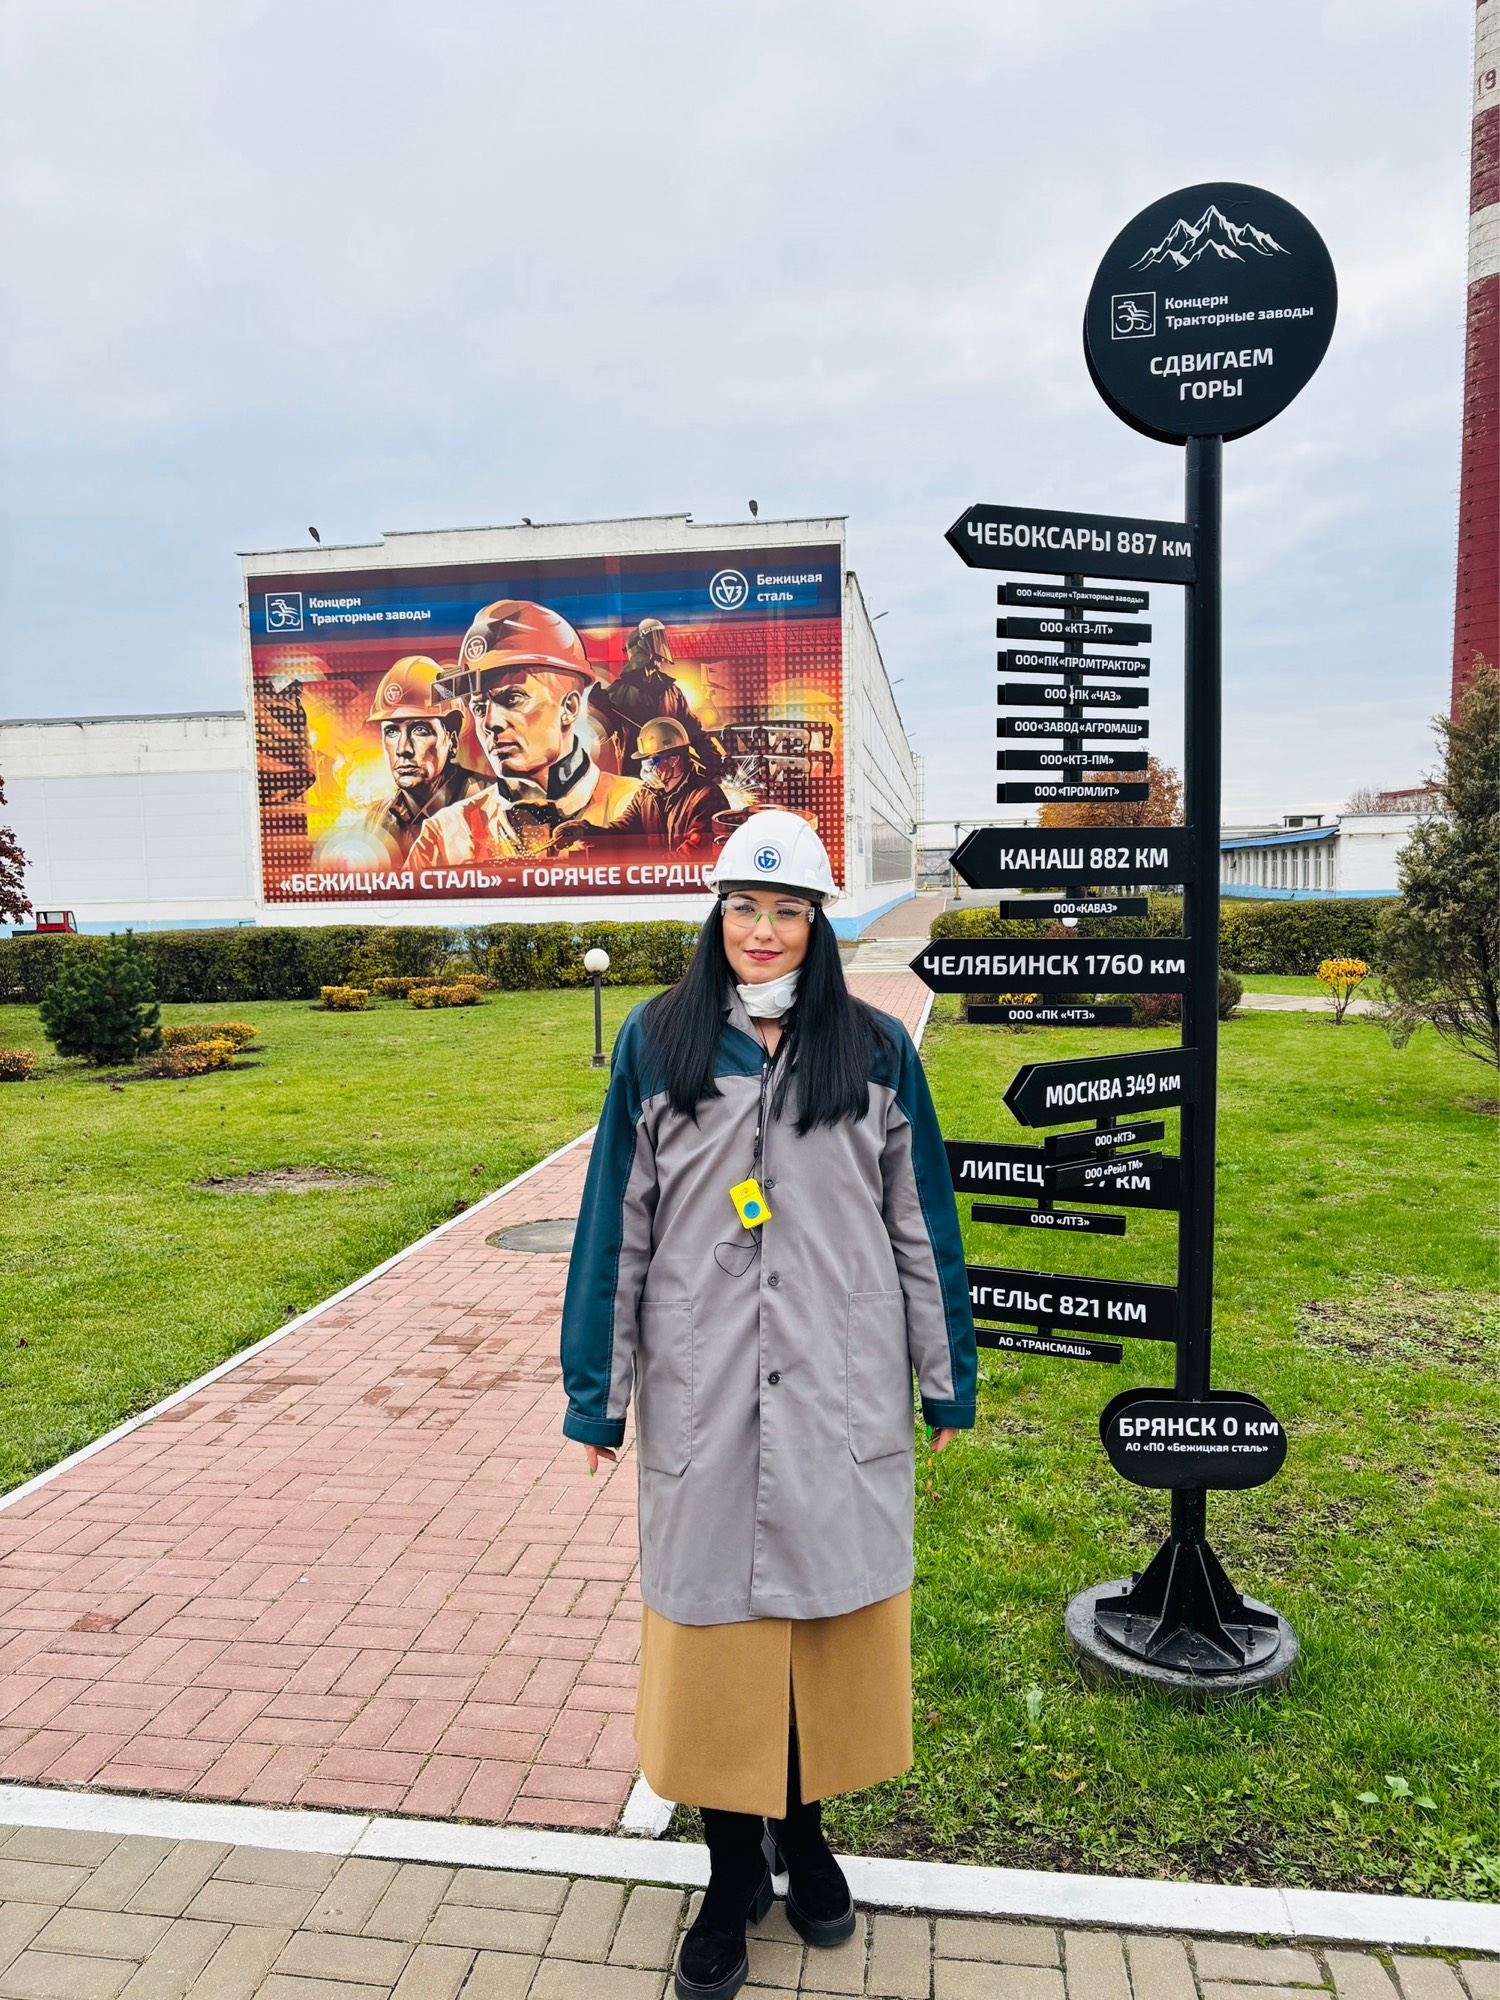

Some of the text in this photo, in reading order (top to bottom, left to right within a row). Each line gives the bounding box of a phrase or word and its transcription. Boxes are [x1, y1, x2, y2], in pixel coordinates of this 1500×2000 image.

[1165, 296, 1228, 309] Концерн
[1165, 307, 1313, 329] Тракторные заводы
[1151, 348, 1273, 377] СДВИГАЕМ
[1180, 379, 1242, 400] ГОРЫ
[968, 522, 1191, 557] ЧЕБОКСАРЫ 887 км
[757, 574, 822, 585] Бежицкая
[309, 598, 361, 609] Концерн
[757, 592, 793, 601] сталь
[1016, 588, 1033, 597] ООО
[1033, 589, 1068, 600] «Концерн
[1068, 590, 1115, 602] «Тракторные
[310, 611, 431, 626] Тракторные заводы
[1040, 622, 1113, 634] ООО «КТЗ-ЛТ»
[1045, 689, 1066, 699] ООО
[1091, 691, 1121, 701] «ЧАЗ»
[1001, 848, 1168, 869] КАНАШ 882 КМ
[279, 869, 415, 894] «БЕЖИЦКАЯ
[420, 868, 502, 891] СТАЛЬ»
[521, 865, 621, 888] ГОРЯЧЕЕ
[924, 955, 1185, 975] ЧЕЛЯБИНСК 1760 км
[1009, 1010, 1095, 1019] ООО «ПК «ЧТЗ»
[1046, 1073, 1180, 1107] МОСКВА 349 км
[1095, 1131, 1136, 1146] ООО «КТЗ»
[960, 1160, 1051, 1186] ЛИПЕЦ
[1085, 1160, 1143, 1179] ООО «Рейл ТМ»
[1031, 1215, 1089, 1225] ООО «ЛТЗ»
[1060, 1296, 1099, 1317] 821
[1108, 1301, 1146, 1323] КМ
[999, 1337, 1091, 1355] АО «ТРАНСМАШ»
[1120, 1417, 1279, 1436] БРЯНСК 0 км
[1126, 1443, 1140, 1451] АО
[1143, 1443, 1164, 1451] «ПО
[1167, 1443, 1229, 1453] «Бежицкая
